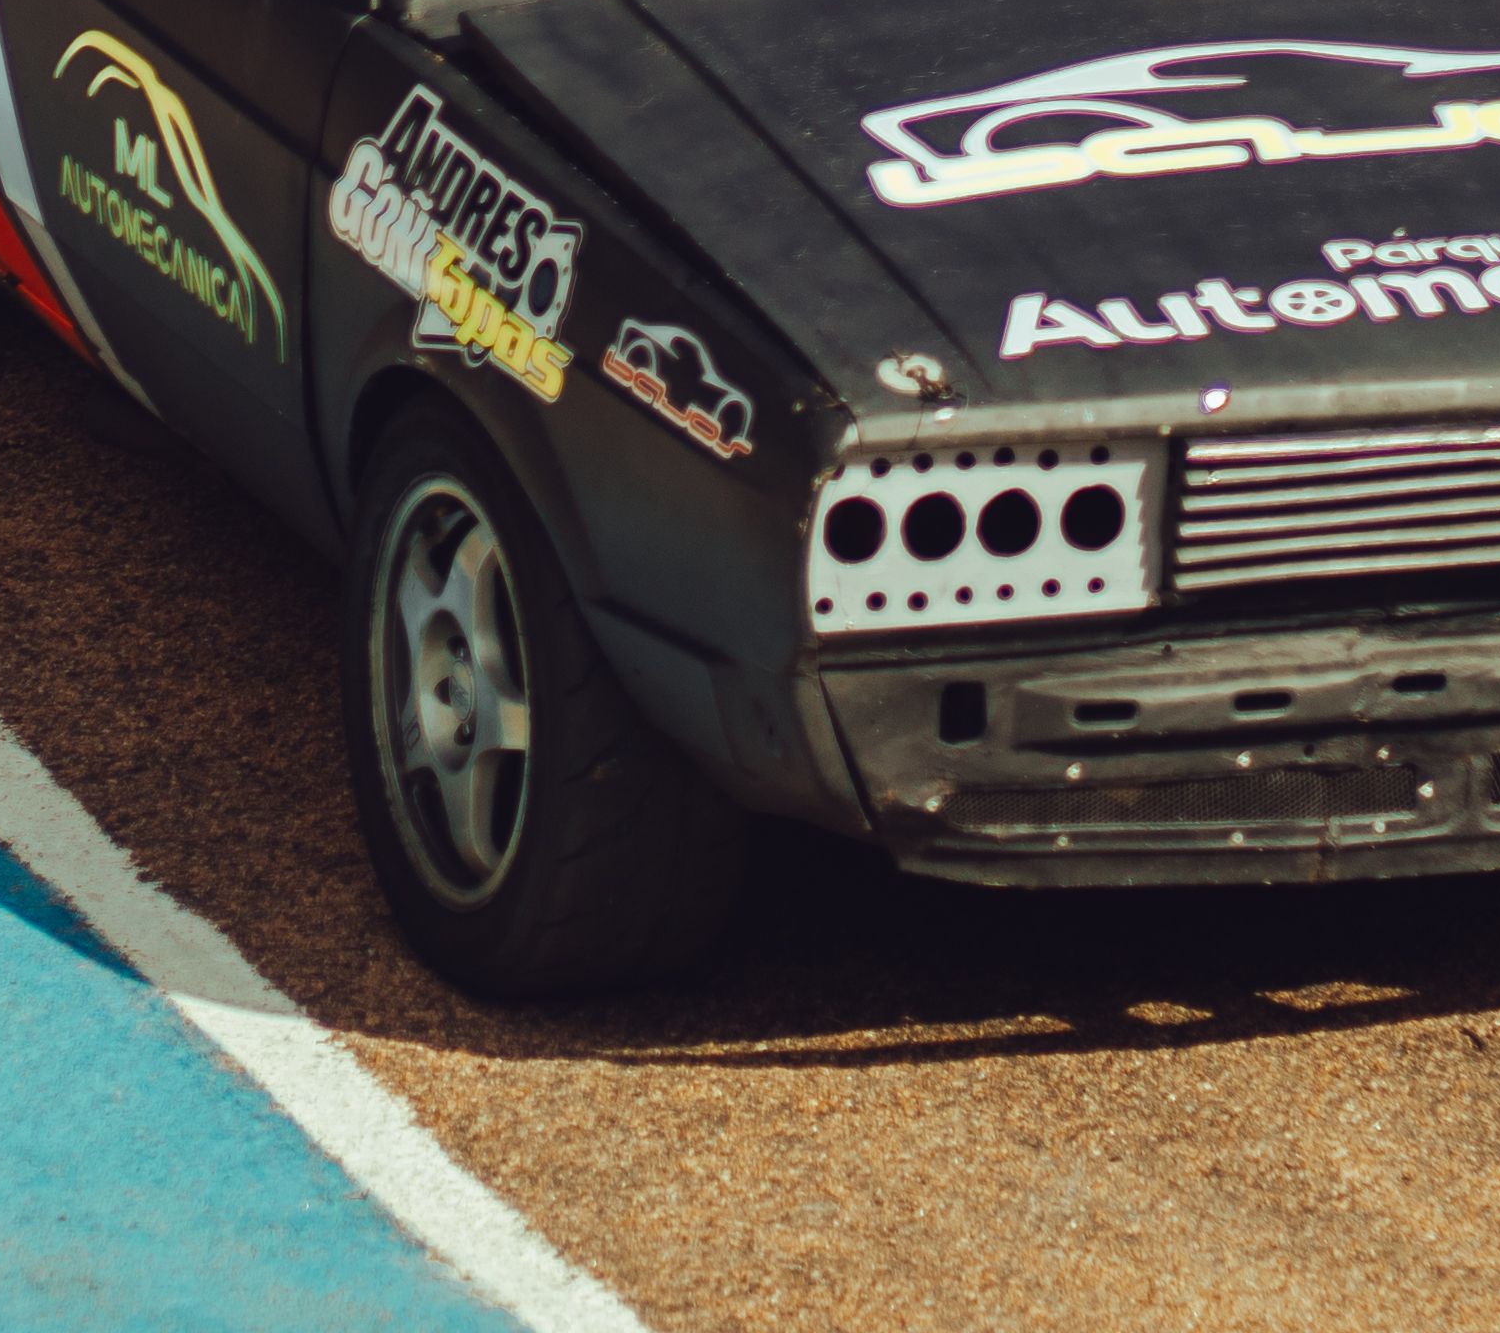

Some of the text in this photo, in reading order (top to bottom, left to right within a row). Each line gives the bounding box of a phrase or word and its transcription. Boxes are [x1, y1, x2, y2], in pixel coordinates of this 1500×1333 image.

[60, 155, 247, 332] AUTOMECANICA
[114, 118, 174, 209] ML
[380, 89, 549, 279] ANDRES
